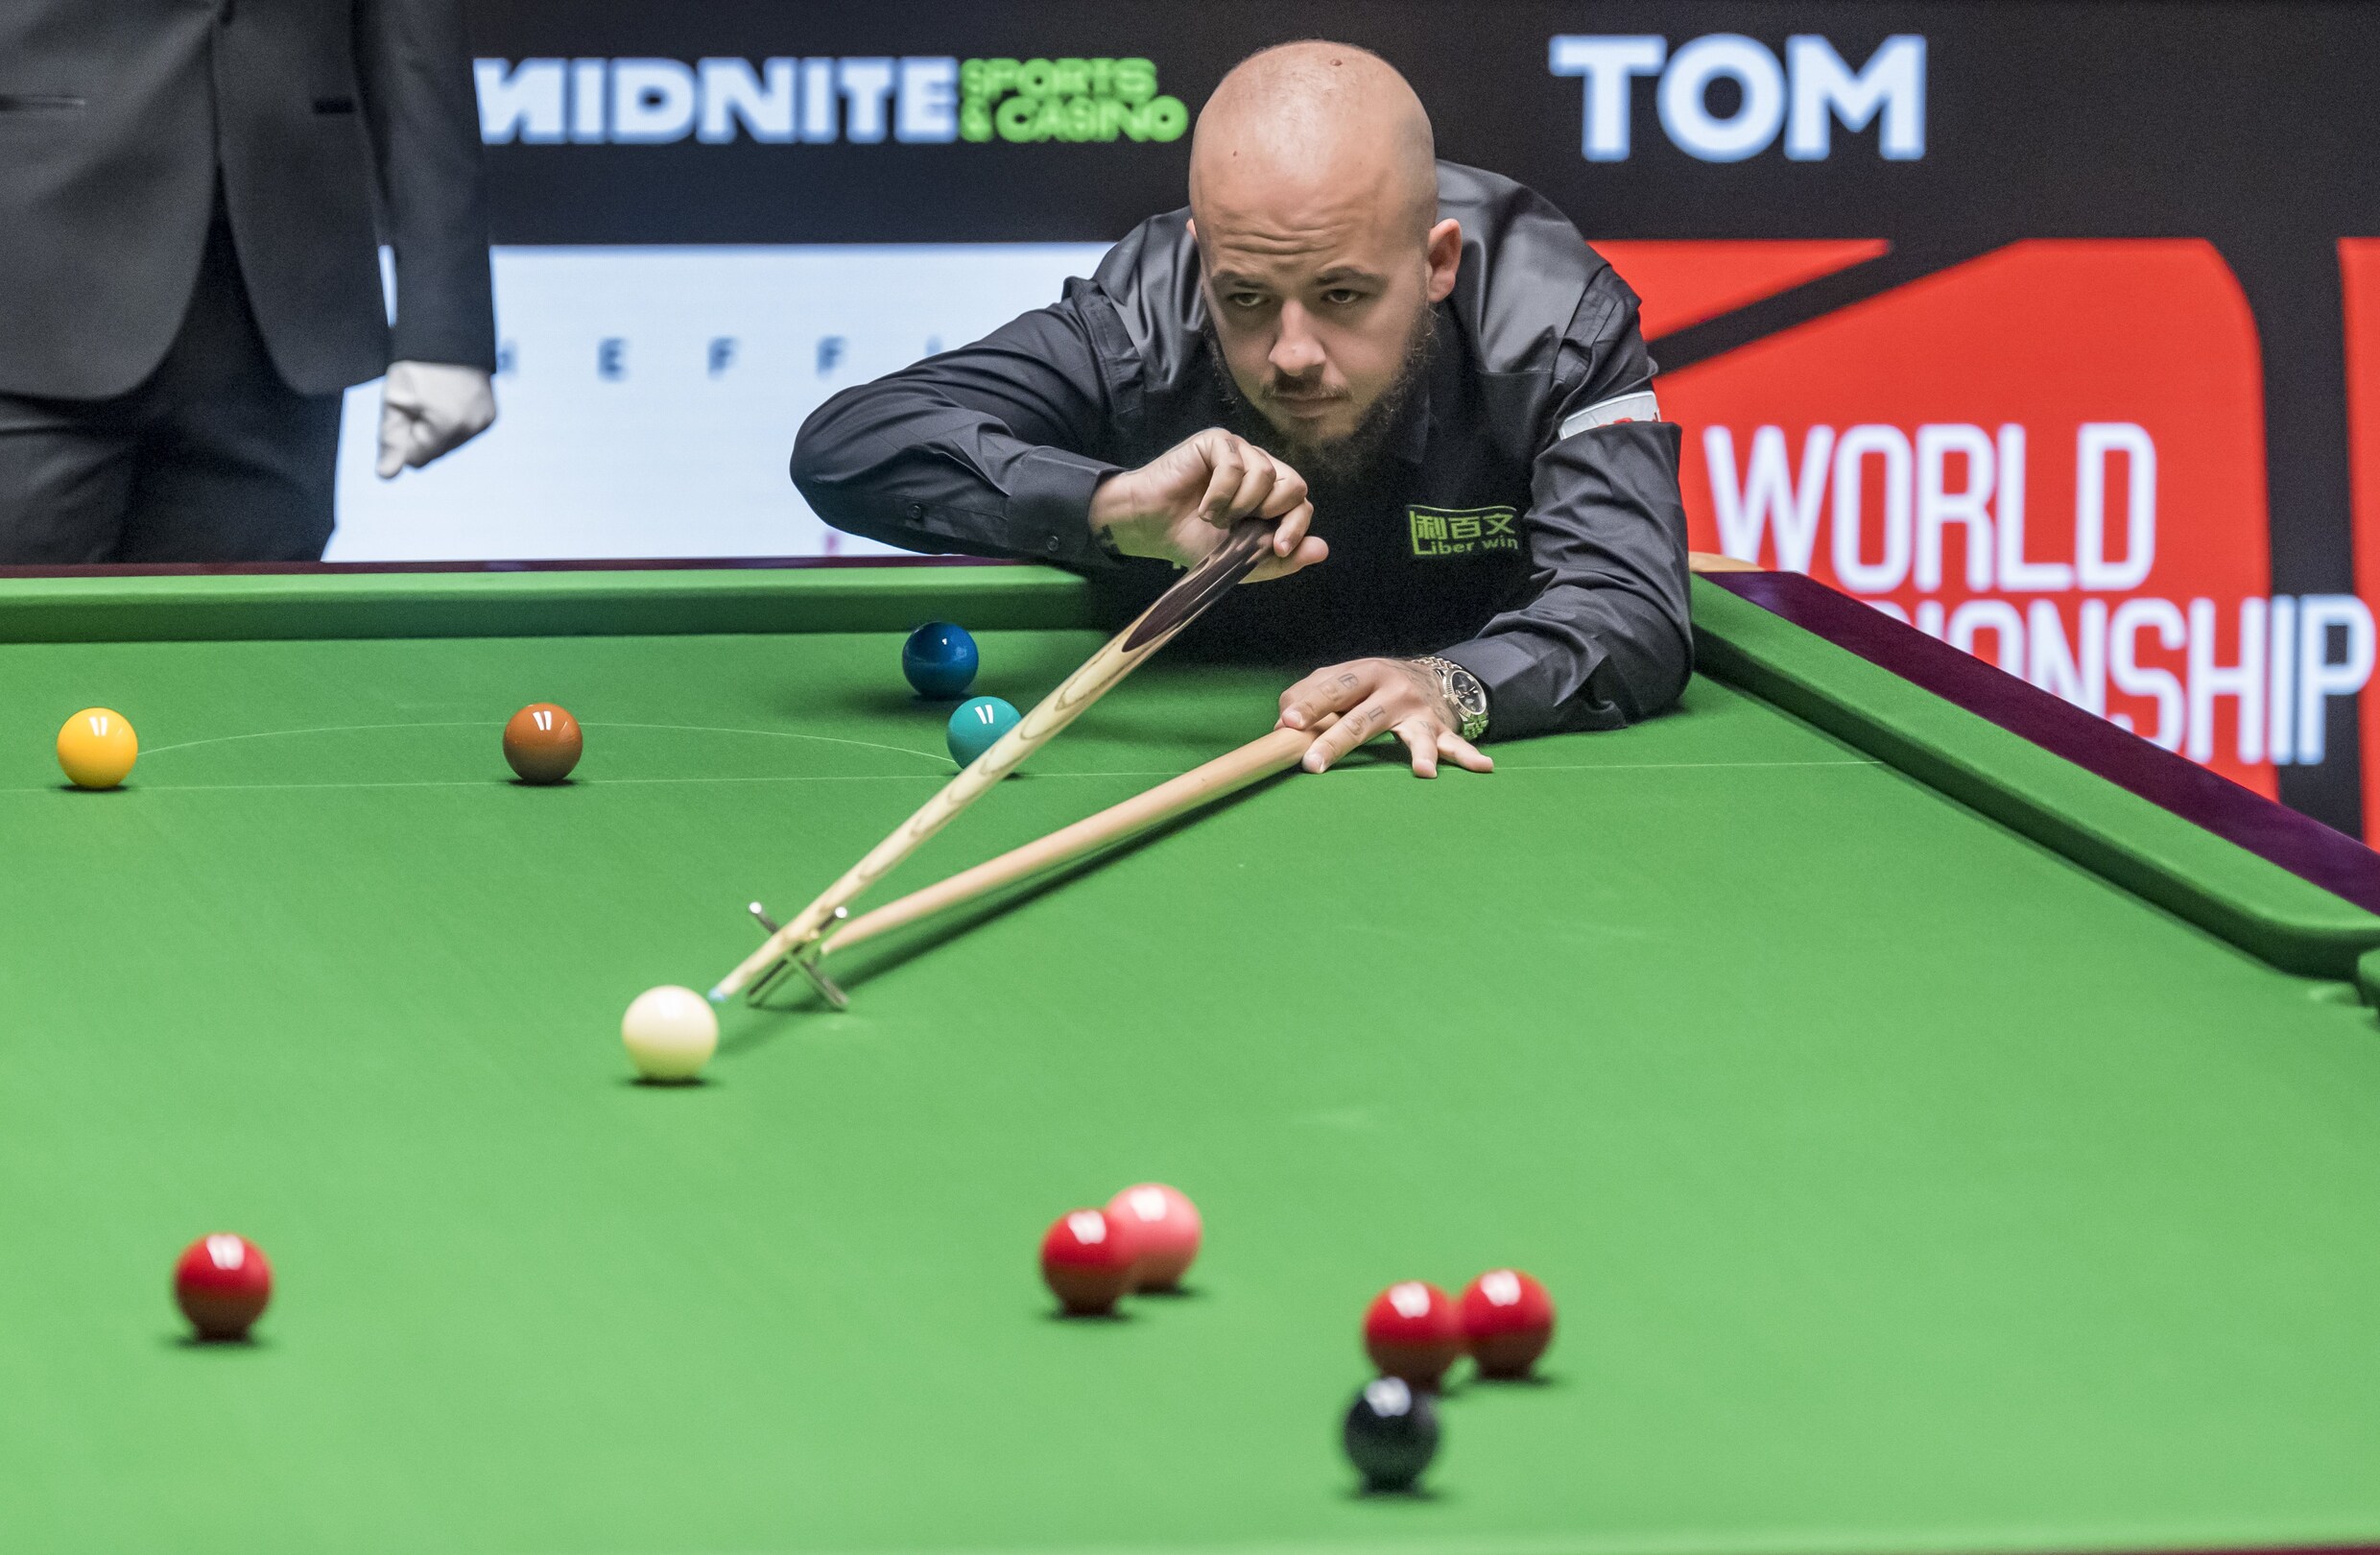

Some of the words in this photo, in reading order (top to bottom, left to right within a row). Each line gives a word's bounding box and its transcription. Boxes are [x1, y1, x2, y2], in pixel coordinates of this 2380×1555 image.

[961, 58, 1157, 100] SPORTS
[1549, 34, 1927, 162] TOM
[995, 95, 1189, 143] CASINO
[1703, 422, 2157, 592] WORLD
[1409, 510, 1475, 556] Liber
[1482, 534, 1518, 550] win
